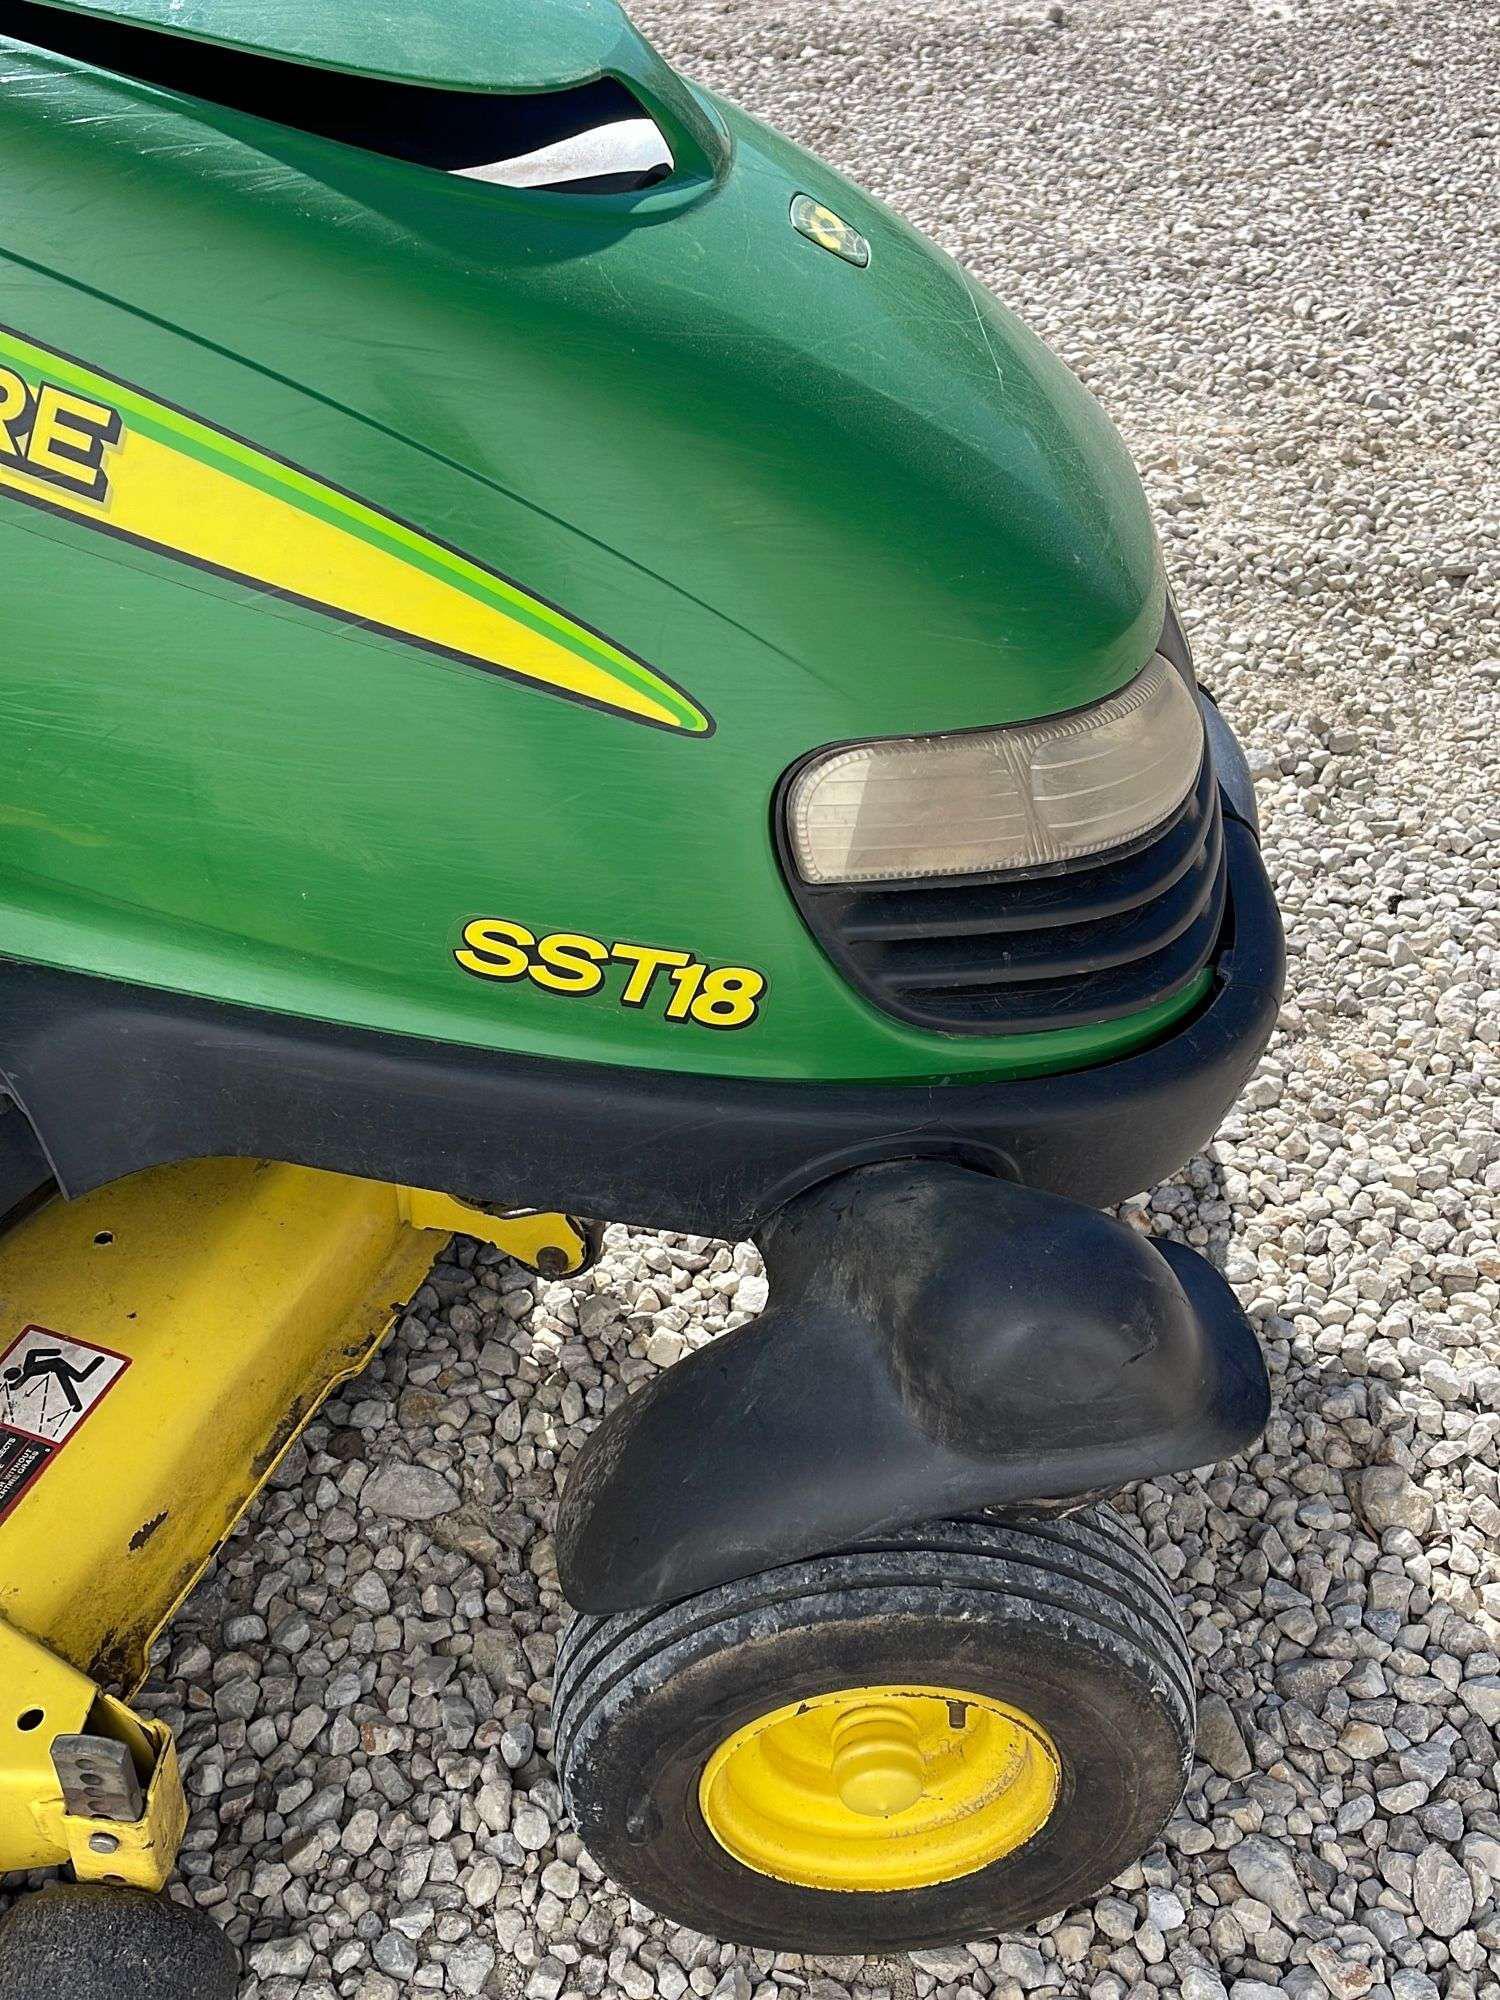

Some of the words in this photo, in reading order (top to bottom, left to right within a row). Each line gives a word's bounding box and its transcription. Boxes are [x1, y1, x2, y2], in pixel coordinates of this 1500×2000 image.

[453, 918, 767, 1031] SST18
[4, 1448, 32, 1480] WITHOUT
[18, 1451, 39, 1474] GRASS
